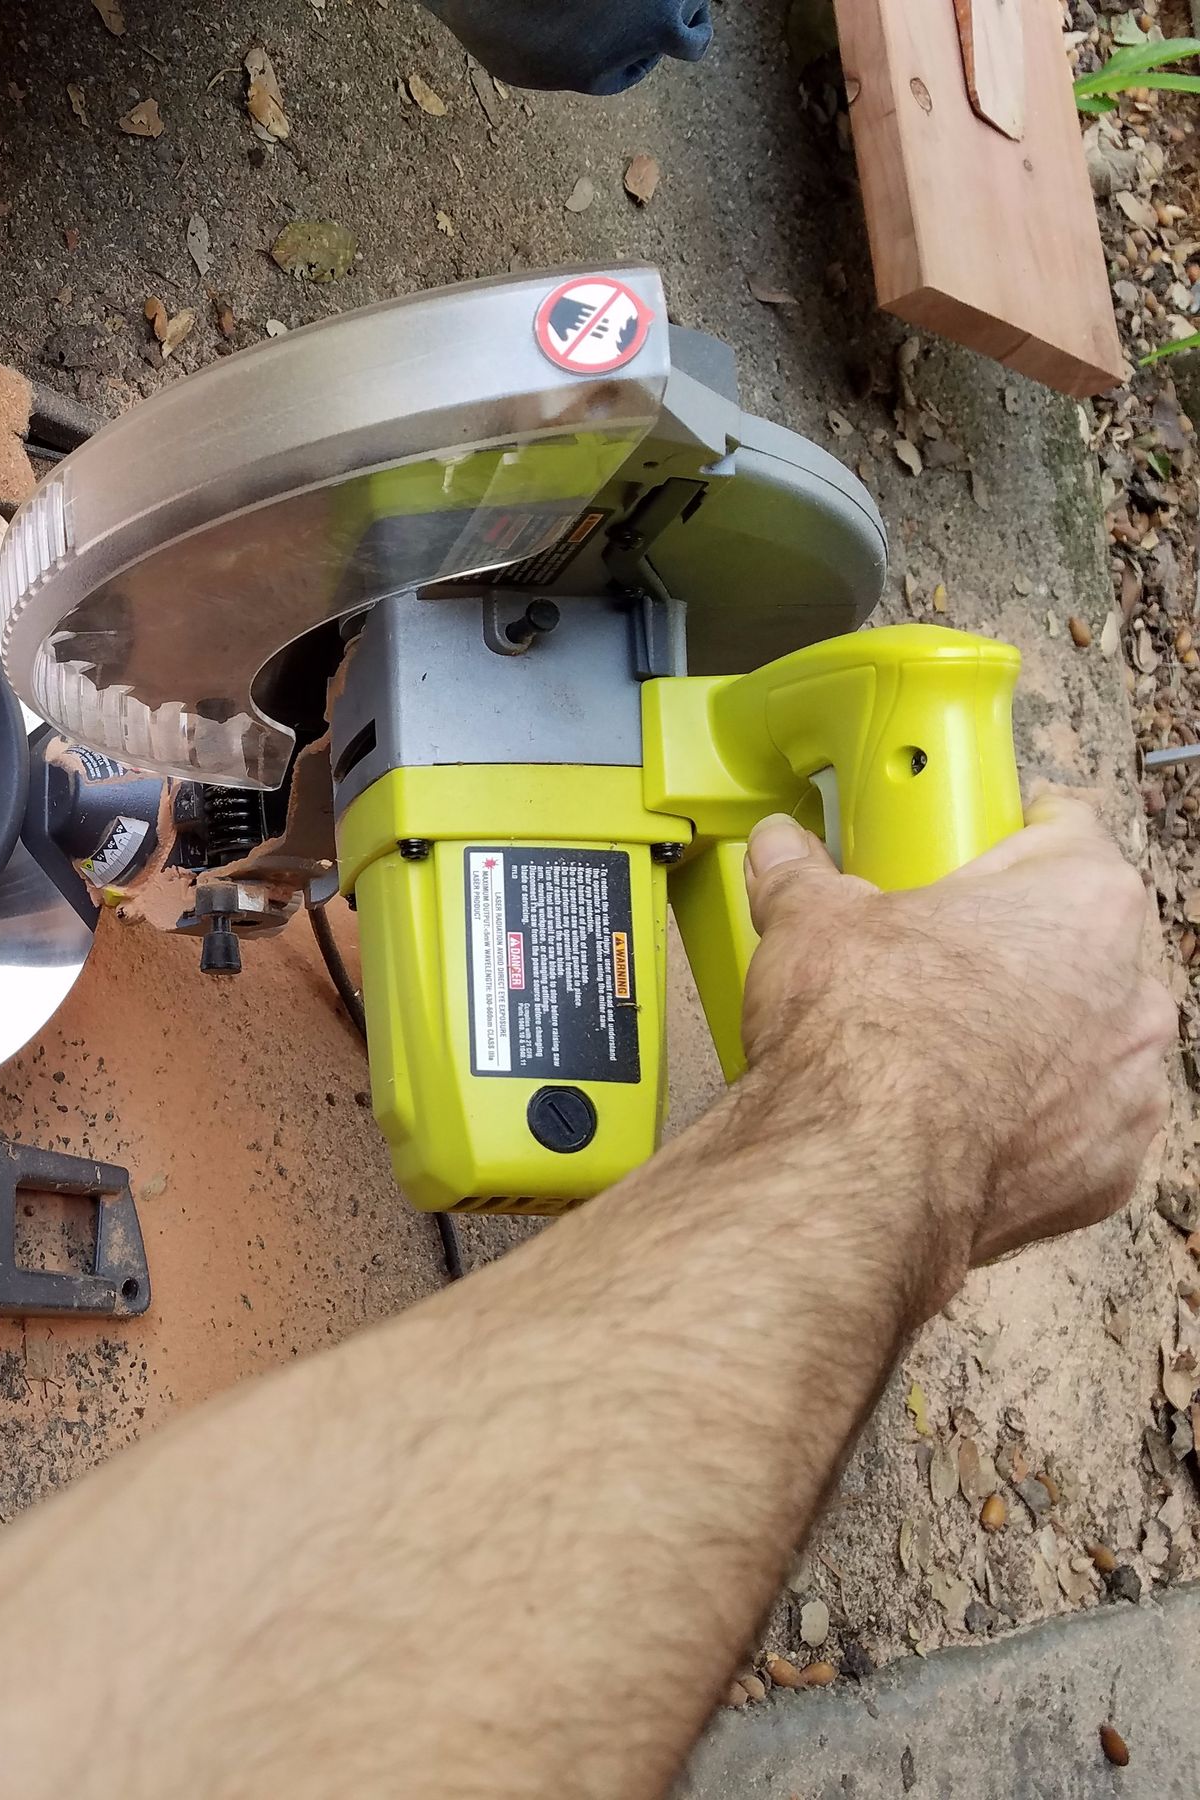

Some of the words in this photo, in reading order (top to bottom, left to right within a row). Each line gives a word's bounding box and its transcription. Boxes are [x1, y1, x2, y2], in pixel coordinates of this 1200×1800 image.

[116, 824, 124, 834] 45
[107, 840, 116, 849] 30
[521, 865, 529, 883] blade
[561, 866, 568, 876] Do
[569, 867, 576, 876] Do
[576, 867, 584, 884] Keep
[584, 867, 593, 885] Wear
[600, 868, 608, 877] To
[529, 865, 538, 901] Disconnect
[537, 882, 546, 906] moving
[584, 886, 592, 898] eye
[601, 878, 609, 900] reduce
[561, 888, 570, 915] perform
[569, 889, 578, 914] operate
[592, 880, 602, 913] operator's
[520, 893, 530, 925] servicing.
[555, 906, 563, 929] around
[584, 899, 595, 934] protection.
[602, 913, 610, 926] risk
[531, 928, 540, 944] from
[579, 926, 587, 941] path
[595, 914, 603, 939] manual
[532, 945, 540, 956] the
[563, 929, 572, 961] operation
[572, 930, 580, 954] without
[510, 947, 522, 985] DANGER
[531, 957, 540, 978] power
[540, 954, 549, 985] changing
[572, 956, 581, 978] guards
[581, 965, 589, 986] blade.
[596, 964, 605, 981] using
[616, 948, 626, 994] WARNING
[565, 962, 574, 994] freehand.
[606, 974, 614, 991] must
[541, 986, 550, 1014] settings.
[549, 989, 558, 1003] stop
[574, 988, 582, 1009] place.
[606, 993, 614, 1008] read
[499, 1004, 507, 1037] EXPOSURE
[534, 1003, 543, 1025] before
[607, 1009, 615, 1022] and
[534, 1026, 544, 1057] changing
[551, 1028, 560, 1052] raising
[608, 1023, 617, 1061] understand
